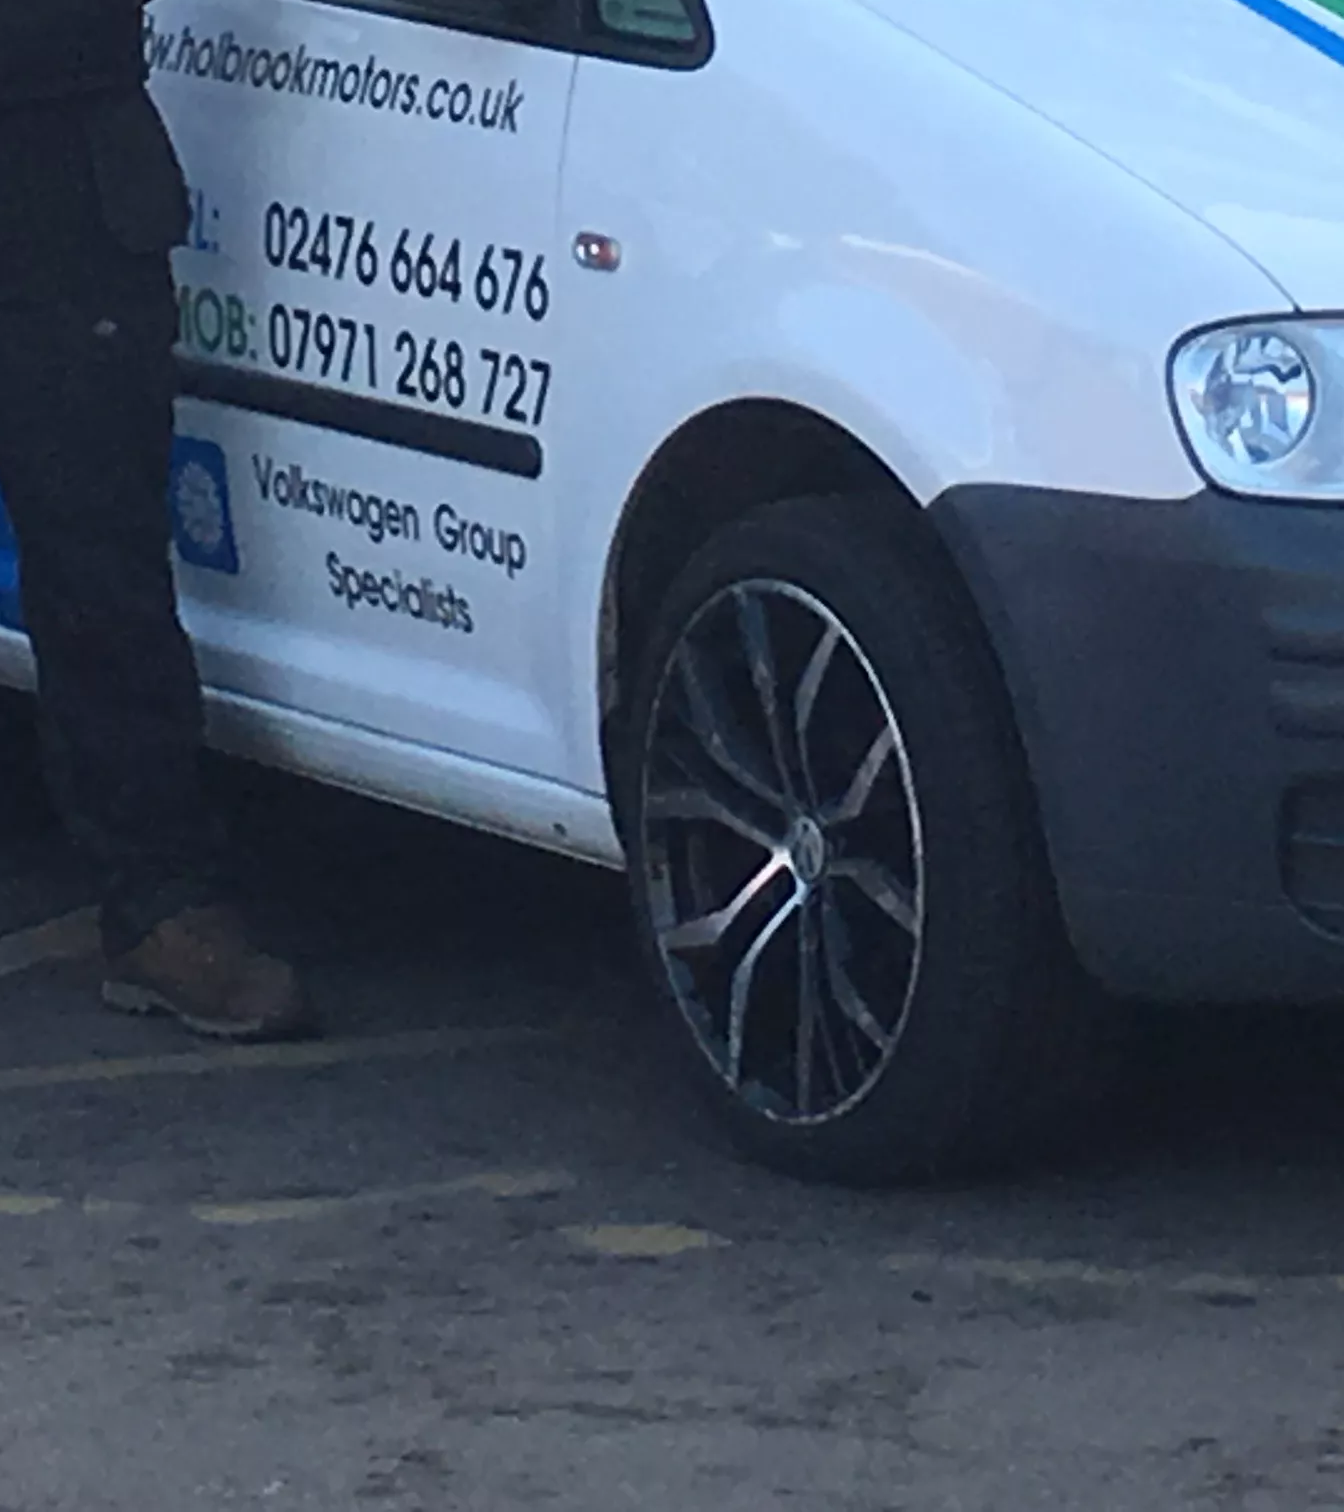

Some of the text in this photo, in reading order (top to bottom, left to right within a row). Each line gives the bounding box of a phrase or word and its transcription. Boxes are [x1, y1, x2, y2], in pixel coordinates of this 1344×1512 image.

[264, 201, 378, 287] 02476
[390, 227, 462, 304] 664
[475, 243, 550, 322] 676
[268, 303, 378, 389] 07971
[395, 334, 467, 410] 268
[480, 347, 552, 427] 727
[253, 452, 528, 579] Volkswagen Group
[325, 551, 475, 634] Specialists
